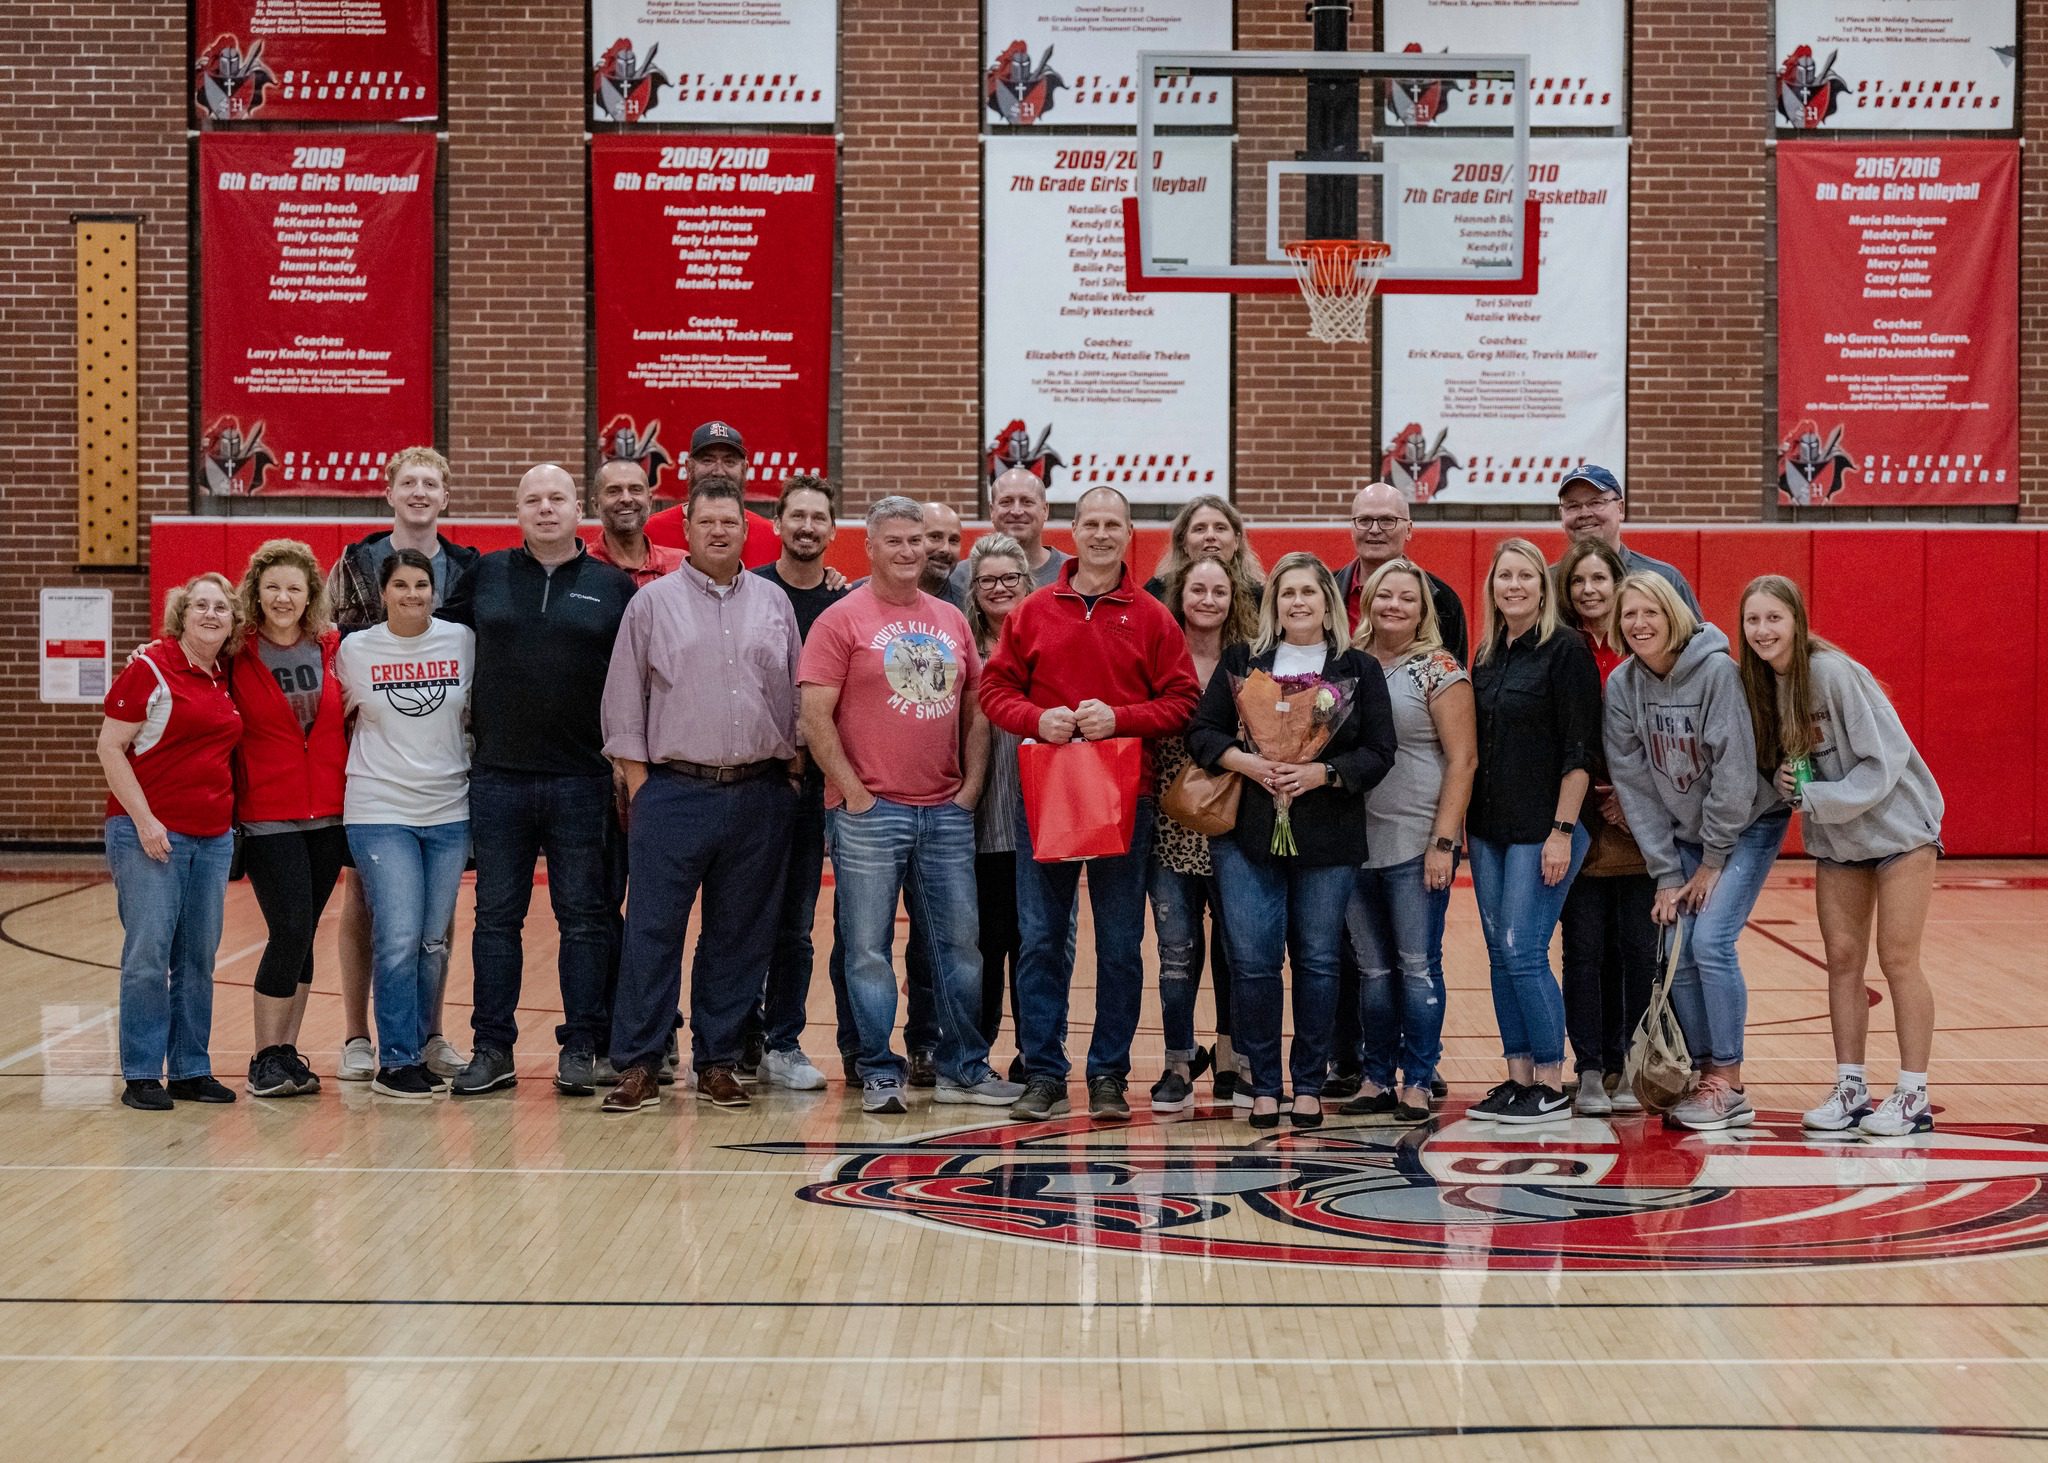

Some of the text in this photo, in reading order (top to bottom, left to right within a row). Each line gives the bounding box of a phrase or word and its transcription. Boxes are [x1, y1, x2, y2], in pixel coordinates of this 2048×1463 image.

[346, 27, 386, 35] Champions
[283, 71, 402, 84] ST. HENRY
[679, 75, 797, 86] ST. HENRY
[284, 86, 425, 99] CRUSADERS
[1858, 81, 1975, 93] ST. HENRY
[679, 90, 820, 101] CRUSADERS
[1076, 92, 1218, 103] CRUSDERS
[1468, 93, 1610, 105] CRUADERS
[1858, 96, 2000, 108] CRUSADERS
[292, 148, 345, 168] 2009
[659, 147, 770, 170] 2009/2010
[1055, 150, 1163, 170] 2009/200
[1452, 164, 1559, 183] 2009/010
[1855, 157, 1941, 179] 2015/2016
[219, 173, 419, 194] 6th Grade Girls Volleyball
[614, 173, 815, 194] 6th Grade Girls Volleyball
[1011, 176, 1128, 192] 7th Grade Girls
[1404, 189, 1607, 205] 7th Grade Girl Basketball
[1816, 183, 1980, 202] 8th Grade Girls Volleyball
[279, 202, 357, 215] Morgan Beach
[664, 206, 766, 217] Hannah Blackburn
[1068, 205, 1107, 214] Natalie
[273, 217, 325, 227] McKenzie
[1071, 220, 1112, 230] Kendyll
[1454, 215, 1497, 223] Hannah
[1883, 215, 1947, 227] Blasingame
[677, 220, 752, 233] Kendyll Kraus
[277, 232, 308, 244] Emily
[672, 235, 758, 247] Karly Lehmkuhl
[1065, 234, 1094, 244] Karly
[1862, 229, 1934, 241] Madelyn Bier
[282, 246, 354, 259] Emma Hendy
[1069, 249, 1098, 259] Emily
[1467, 243, 1508, 253] Kendyll
[1858, 244, 1897, 254] Jessica
[712, 250, 750, 260] Parker
[280, 261, 317, 271] Hanna
[686, 264, 743, 277] Molly Rice
[1867, 259, 1928, 271] Mercy John
[270, 275, 303, 288] Layne
[676, 279, 753, 289] Natalie Weber
[1080, 278, 1099, 286] Tori
[1865, 273, 1931, 285] Casey Miller
[269, 290, 367, 303] Abby Ziegelmeyer
[1069, 292, 1146, 301] Natalie Weber
[1863, 288, 1932, 298] Emma Quinn
[1476, 299, 1532, 307] Tori Silvati
[1060, 307, 1154, 317] Emily Westerbeck
[1465, 313, 1541, 321] Natalie Weber
[688, 316, 738, 327] Coaches:
[1873, 319, 1922, 329] Coaches:
[294, 335, 344, 346] Coaches:
[633, 329, 666, 340] Laura
[726, 330, 760, 341] Tracie
[760, 330, 793, 341] Kraus
[1479, 336, 1526, 345] Coaches:
[1824, 333, 1846, 343] Bob
[1891, 333, 1928, 343] Donna
[1084, 338, 1132, 347] Coaches:
[247, 349, 277, 361] Larry
[321, 349, 356, 359] Laurie
[357, 350, 391, 360] Bauer
[1026, 351, 1190, 360] Elizabeth Dietz, Natalie Thelen
[1408, 350, 1597, 360] Eric Kraus, Greg Miller, Travis Miller
[1841, 348, 1877, 358] Daniel
[284, 452, 319, 465] ST.
[1072, 454, 1189, 466] ST. HENRY
[1468, 457, 1502, 468] ST.
[1864, 455, 1982, 468] ST. HENRY
[1072, 470, 1214, 482] CRUSADERS
[1864, 470, 2006, 483] CRUSADERS
[870, 621, 957, 650] YOU'RE KILLING
[371, 659, 460, 683] CRUSADER
[272, 664, 318, 693] GO
[375, 679, 458, 691] BASKETBALL
[887, 693, 956, 720] ME SMALLS
